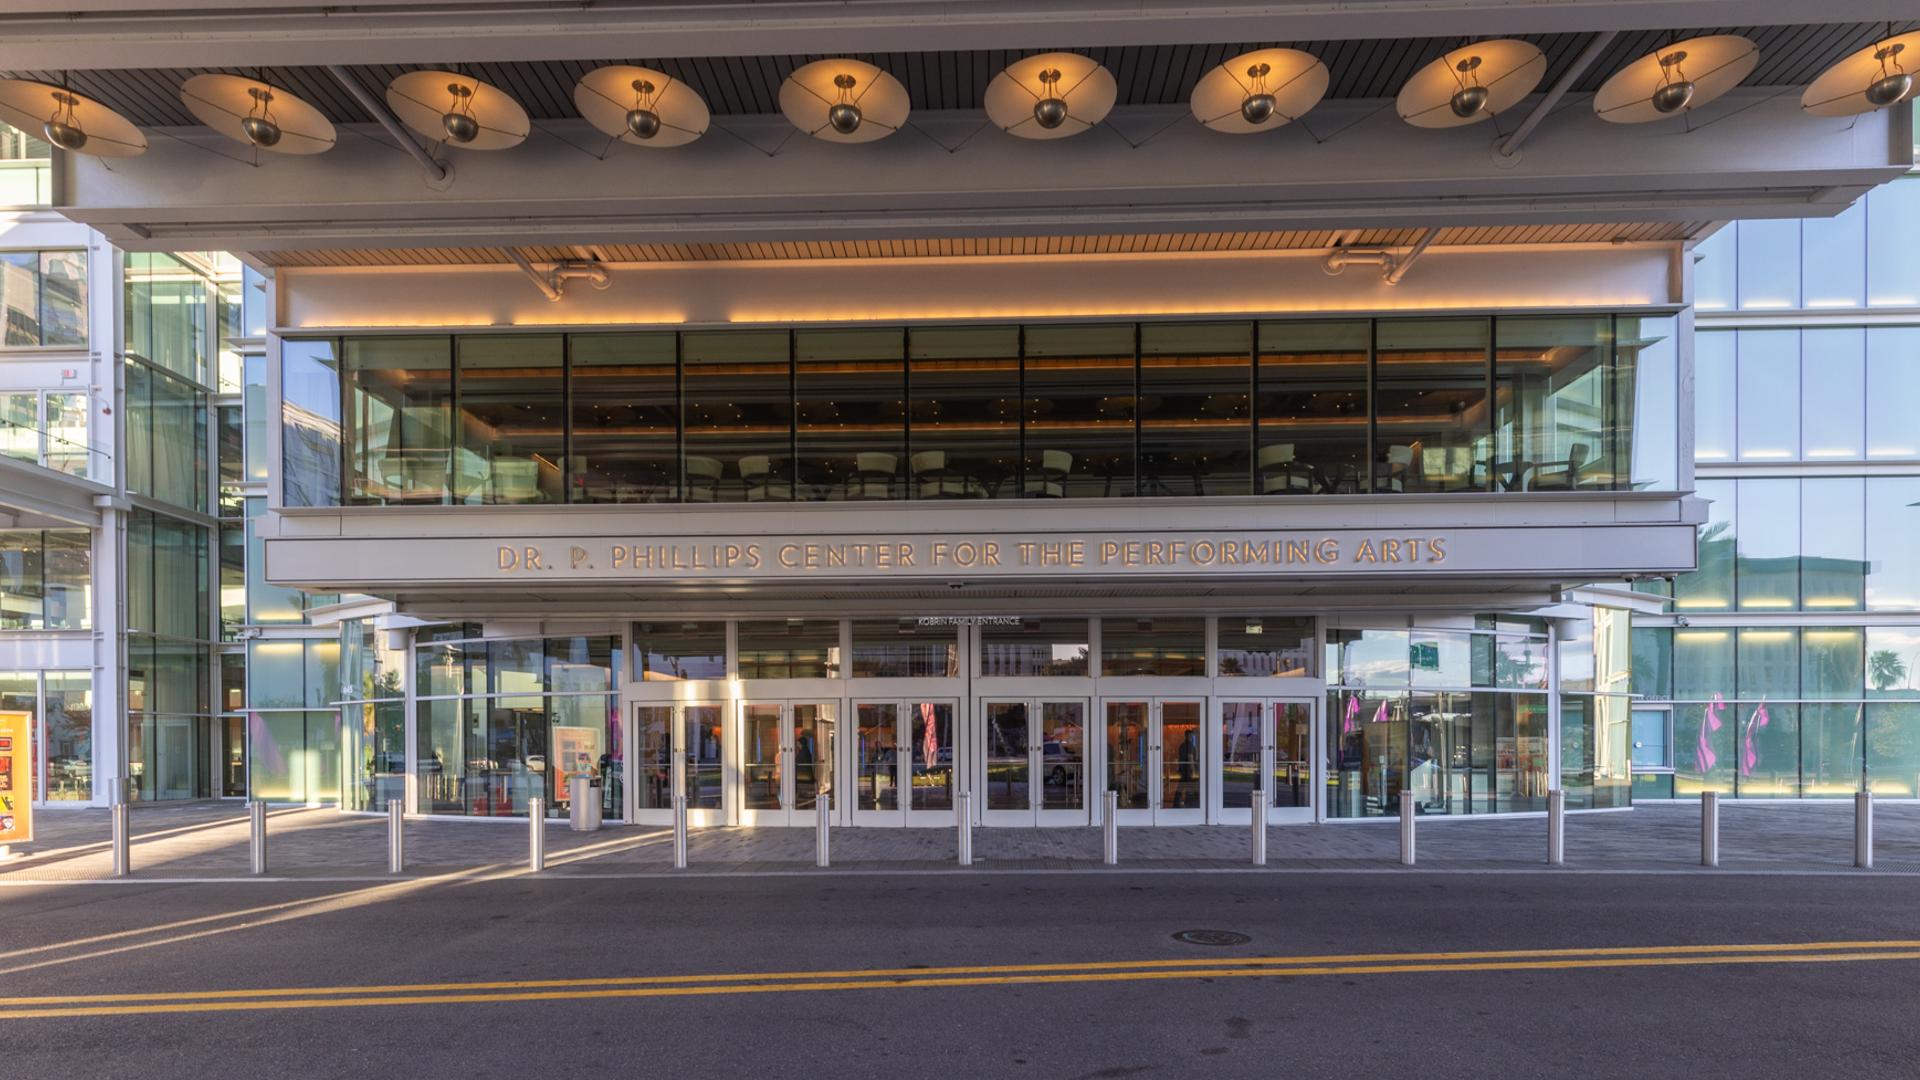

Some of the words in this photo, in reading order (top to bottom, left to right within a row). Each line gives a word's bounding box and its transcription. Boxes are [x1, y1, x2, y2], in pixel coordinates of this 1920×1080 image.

[497, 545, 554, 570] DR.
[570, 544, 594, 570] P.
[611, 543, 760, 570] PHILLIPS
[778, 543, 916, 569] CENTER
[931, 542, 1002, 568] FOR
[1017, 540, 1086, 568] THE
[1101, 538, 1340, 566] PERFORMING
[1354, 537, 1447, 564] ARTS
[918, 616, 948, 626] KOBRIN
[948, 616, 977, 626] FAMILY
[977, 615, 1020, 626] ENTRANCE
